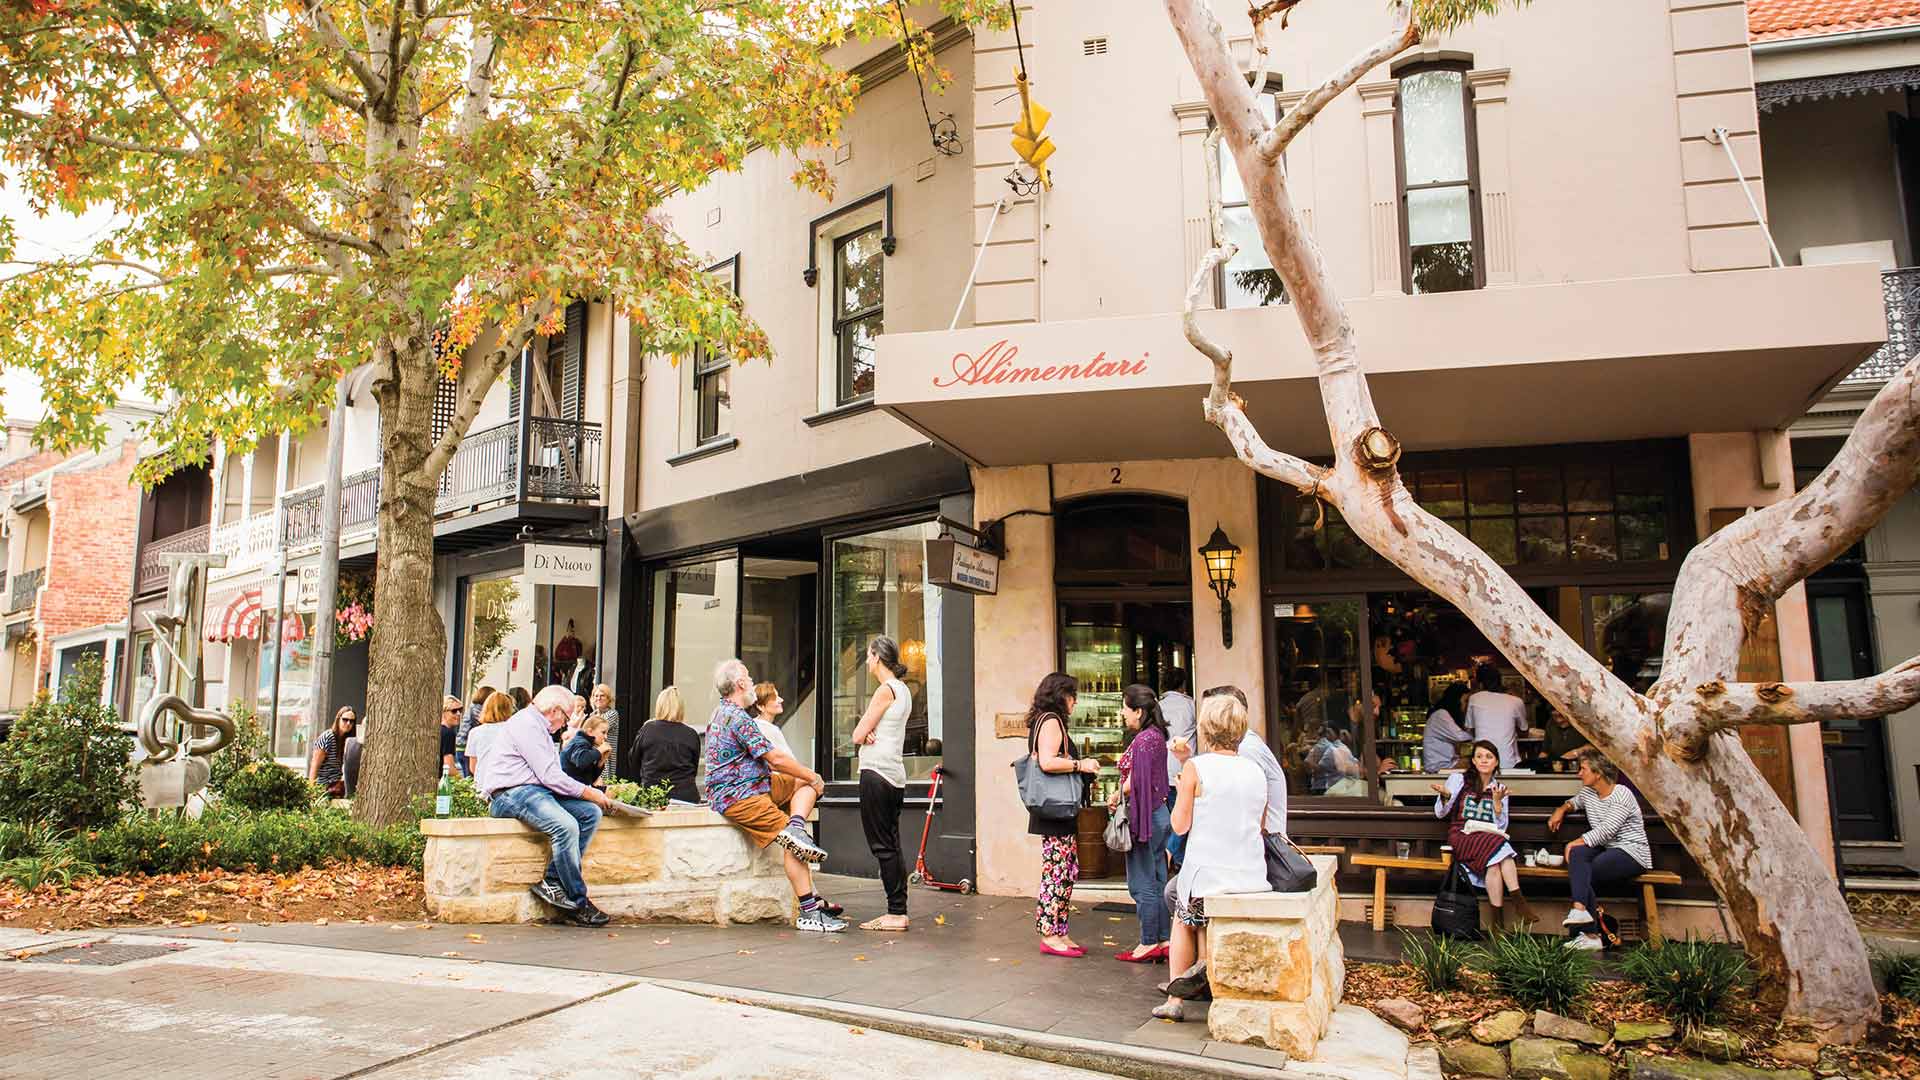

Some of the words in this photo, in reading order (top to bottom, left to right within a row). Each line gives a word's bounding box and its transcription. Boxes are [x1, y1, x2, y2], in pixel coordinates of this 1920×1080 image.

[933, 339, 1150, 387] Alimentari
[1110, 467, 1122, 484] 2
[534, 553, 550, 569] Di
[553, 555, 592, 571] Nuovo
[304, 567, 320, 579] ONE
